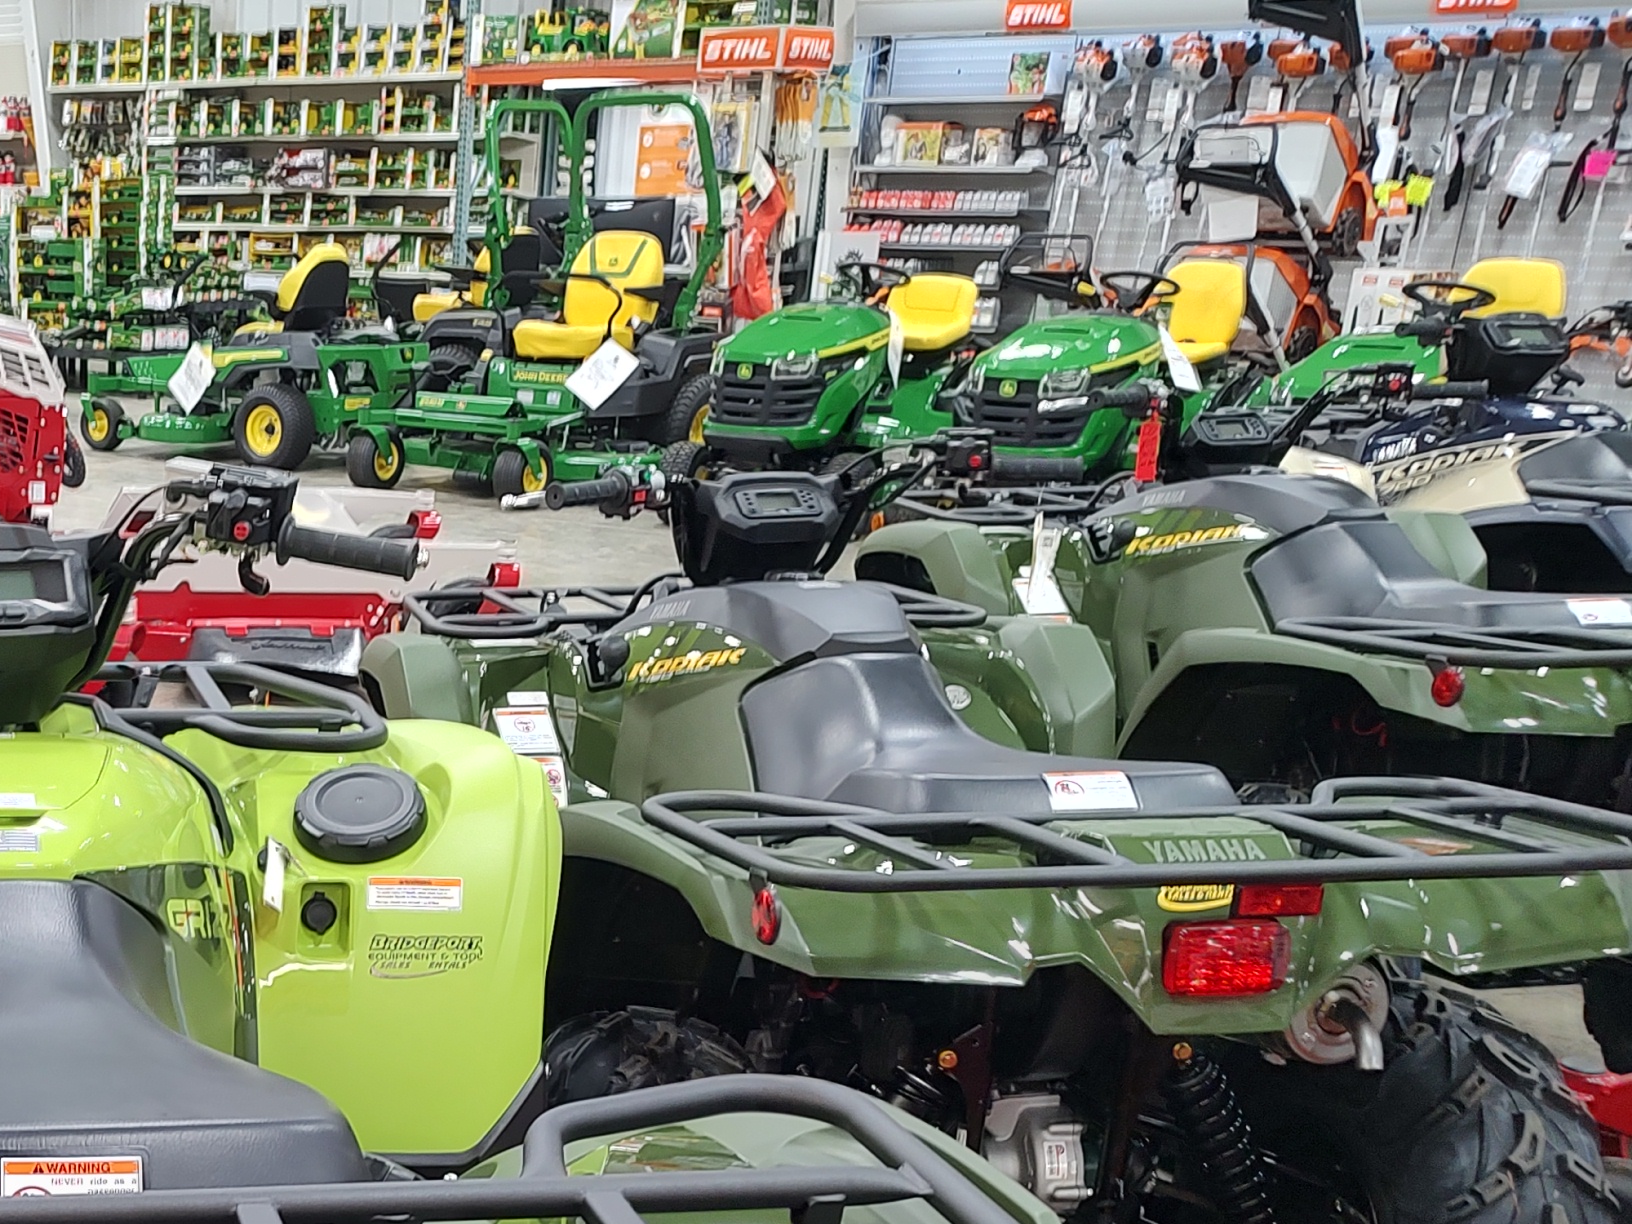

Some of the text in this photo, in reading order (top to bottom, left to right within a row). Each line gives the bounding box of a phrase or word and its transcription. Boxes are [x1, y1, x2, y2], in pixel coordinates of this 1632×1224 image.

[1008, 3, 1066, 26] STIHL
[704, 37, 772, 61] STIHL
[788, 36, 832, 60] STIHL
[1142, 489, 1186, 507] YAMAHA
[627, 648, 747, 682] KODIAK
[1142, 838, 1267, 864] YAMAHA
[369, 934, 483, 951] BRIDGEPORT
[368, 952, 436, 961] EQUIPMENT
[47, 1162, 111, 1173] WARNING
[52, 1177, 84, 1186] NEVER
[90, 1177, 108, 1185] ride
